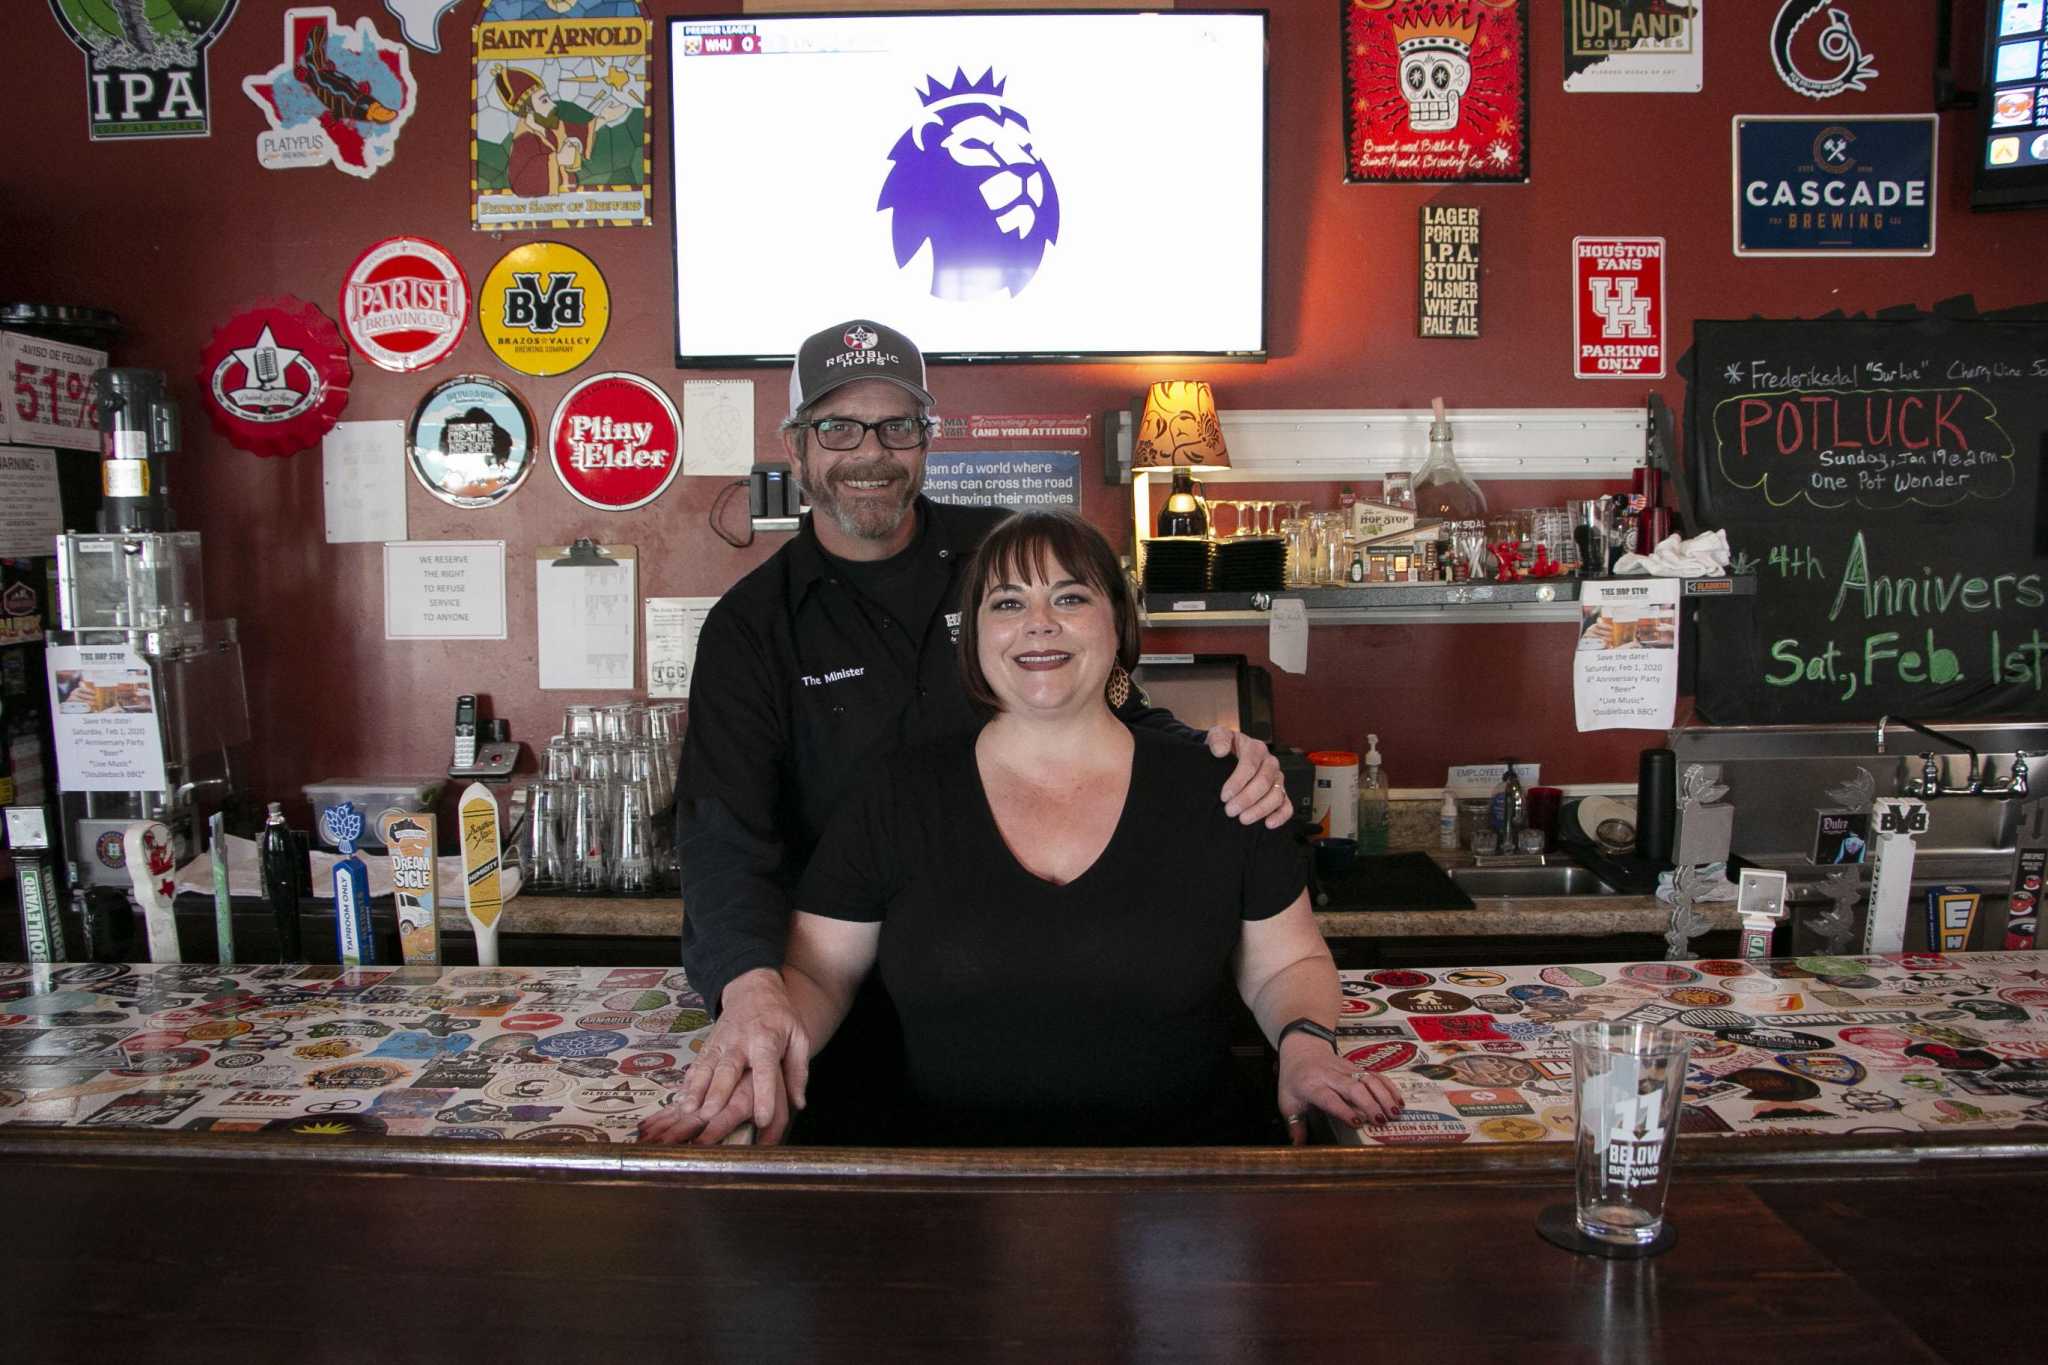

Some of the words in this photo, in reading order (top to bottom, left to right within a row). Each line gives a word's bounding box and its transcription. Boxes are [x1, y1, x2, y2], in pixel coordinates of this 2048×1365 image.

[1582, 2, 1684, 38] UPLAND
[482, 28, 547, 50] SAINT
[545, 24, 643, 54] ARNOLD
[705, 38, 732, 52] WHU
[741, 36, 754, 52] 0
[1582, 39, 1631, 49] SOUR
[1640, 39, 1684, 48] ALES
[92, 72, 204, 120] IPA
[264, 134, 324, 153] PLATYPUS
[1458, 138, 1471, 159] by
[1360, 154, 1388, 167] Saint
[1423, 153, 1467, 173] Brewing
[1746, 180, 1926, 206] CASCADE
[1424, 207, 1479, 225] LAGER
[1788, 213, 1884, 230] BREWING
[1424, 225, 1479, 243] PORTER
[1424, 243, 1479, 262] I.P.A.
[1579, 245, 1660, 257] HOUSTON
[1424, 263, 1478, 280] STOUT
[1597, 258, 1643, 270] FANS
[1424, 280, 1478, 298] PILSNER
[352, 278, 459, 321] PARISH
[1424, 299, 1478, 316] WHEAT
[1588, 277, 1652, 338] UH
[365, 310, 428, 331] BREWING
[1423, 316, 1453, 335] PALE
[1456, 318, 1478, 335] ALE
[498, 337, 541, 346] BRAZOS
[548, 337, 591, 346] VALLEY
[514, 345, 543, 354] BREWING
[544, 345, 574, 354] COMPANY
[826, 350, 900, 368] REPUBLIC
[1581, 345, 1659, 357] PARKING
[842, 356, 885, 368] HOPS
[1598, 358, 1643, 370] ONLY
[570, 415, 653, 448] Pliny
[972, 428, 999, 438] (AND
[1000, 427, 1030, 437] YOUR
[1032, 426, 1088, 437] ATTITUDE)
[1738, 393, 1970, 456] POTLUCK
[583, 442, 670, 471] Elder
[1819, 449, 1896, 473] Sunday,
[1896, 451, 1927, 466] Jan
[926, 464, 949, 475] eam
[951, 462, 966, 475] of
[966, 464, 974, 474] a
[976, 461, 1011, 475] world
[1012, 461, 1052, 474] where
[923, 477, 958, 490] ckens
[960, 479, 982, 490] can
[984, 479, 1020, 490] cross
[1022, 477, 1042, 489] the
[1044, 476, 1073, 489] road
[1811, 472, 1849, 491] One
[1858, 470, 1887, 490] Pot
[1894, 468, 1970, 492] Wonder
[952, 492, 992, 507] having
[994, 492, 1024, 505] their
[1025, 491, 1074, 504] motives
[1360, 515, 1382, 525] HOP
[1384, 515, 1409, 526] STOP
[419, 555, 433, 564] WE
[434, 555, 469, 564] RESERVE
[424, 570, 439, 578] THE
[441, 570, 465, 578] RIGHT
[1767, 544, 1826, 579] 4th
[1828, 529, 2046, 622] Annivers
[436, 584, 465, 592] REFUSE
[1600, 587, 1615, 596] THE
[1616, 587, 1630, 596] HOP
[1631, 587, 1649, 595] STOP
[429, 599, 460, 607] SERVICE
[424, 613, 435, 621] TO
[436, 613, 470, 621] ANYONE
[80, 652, 93, 661] THE
[95, 652, 107, 661] HOP
[109, 652, 126, 661] STOP
[1596, 653, 1614, 661] Save
[801, 676, 822, 687] The
[824, 666, 865, 684] Minister
[1765, 638, 1857, 702] Sat,
[1596, 675, 1638, 684] Anniversary
[1640, 675, 1660, 684] Party
[85, 739, 125, 747] Anniversary
[391, 855, 431, 871] DREAM
[393, 870, 431, 889] SICLE
[341, 877, 350, 903] ONLY
[23, 876, 48, 963] BOULEVARD
[344, 907, 353, 951] TAPROOM
[1763, 1010, 1910, 1026] COMMUNITY
[1727, 1033, 1752, 1041] NEW
[1460, 1104, 1525, 1112] GREENBELT
[1367, 1125, 1415, 1133] ELECTION
[1607, 1143, 1662, 1165] BELOW
[1607, 1164, 1660, 1177] BREWING
